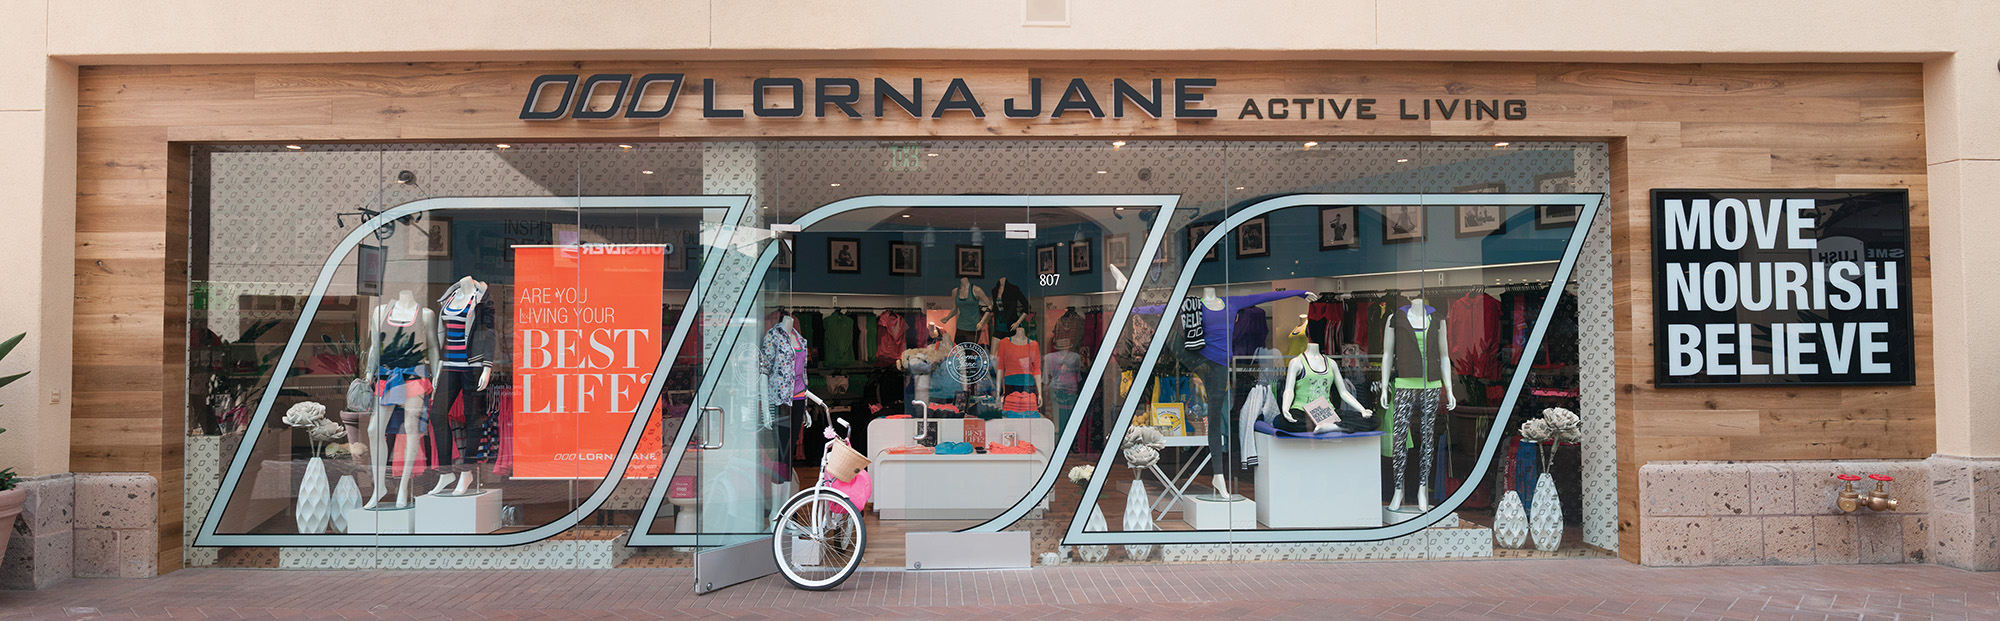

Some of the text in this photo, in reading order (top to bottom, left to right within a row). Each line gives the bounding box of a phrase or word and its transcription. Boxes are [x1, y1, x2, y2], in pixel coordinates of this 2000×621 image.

[703, 78, 1219, 120] LORNA JANE
[1238, 98, 1528, 120] ACTIVE LIVING
[584, 224, 615, 241] YOU
[620, 225, 638, 242] TO
[642, 227, 671, 243] LIVE
[1664, 198, 1817, 251] MOVE
[1039, 273, 1060, 287] 807
[1666, 261, 1899, 313] NOURISH
[520, 287, 588, 304] ARE YOU
[519, 307, 568, 324] LIVING
[573, 307, 615, 324] YOUR
[518, 328, 649, 370] BEST
[1668, 321, 1892, 377] BELIEVE
[629, 453, 658, 461] ANE
